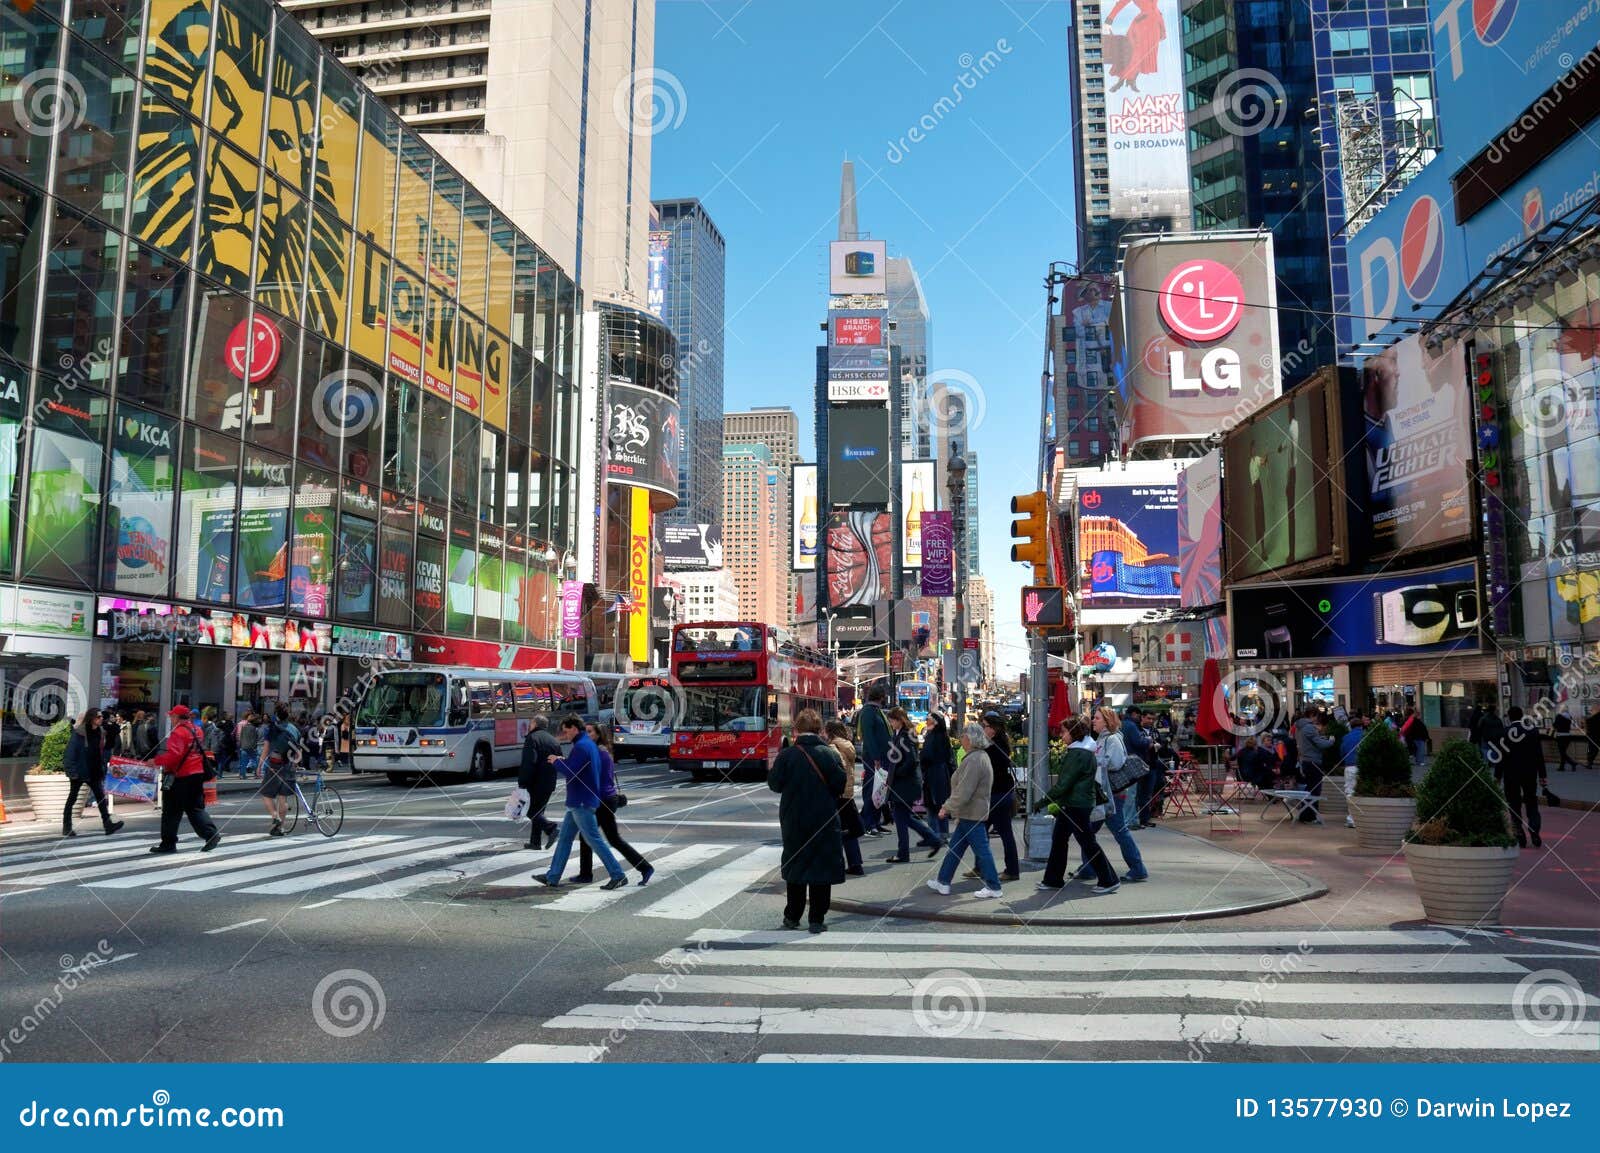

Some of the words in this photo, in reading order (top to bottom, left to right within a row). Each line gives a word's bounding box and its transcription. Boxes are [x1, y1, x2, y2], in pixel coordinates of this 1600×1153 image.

[1122, 94, 1180, 116] MARY
[1114, 141, 1130, 150] ON
[416, 213, 457, 277] THE
[363, 230, 435, 344] LION
[438, 288, 500, 384] KING
[391, 357, 419, 379] ENTRANCE
[426, 375, 435, 388] ON
[1169, 347, 1241, 391] LG
[831, 385, 866, 397] HSBC
[140, 422, 170, 449] KCA
[1376, 426, 1459, 468] ULTIMATE
[263, 463, 286, 486] KCA
[1372, 443, 1457, 493] FIGHTER
[429, 515, 444, 532] KCA
[926, 539, 947, 549] FREE
[927, 549, 947, 559] WIFI
[382, 549, 406, 572] LIVE
[416, 559, 440, 579] KEVIN
[631, 534, 647, 617] Kodak
[382, 578, 406, 600] 8PM
